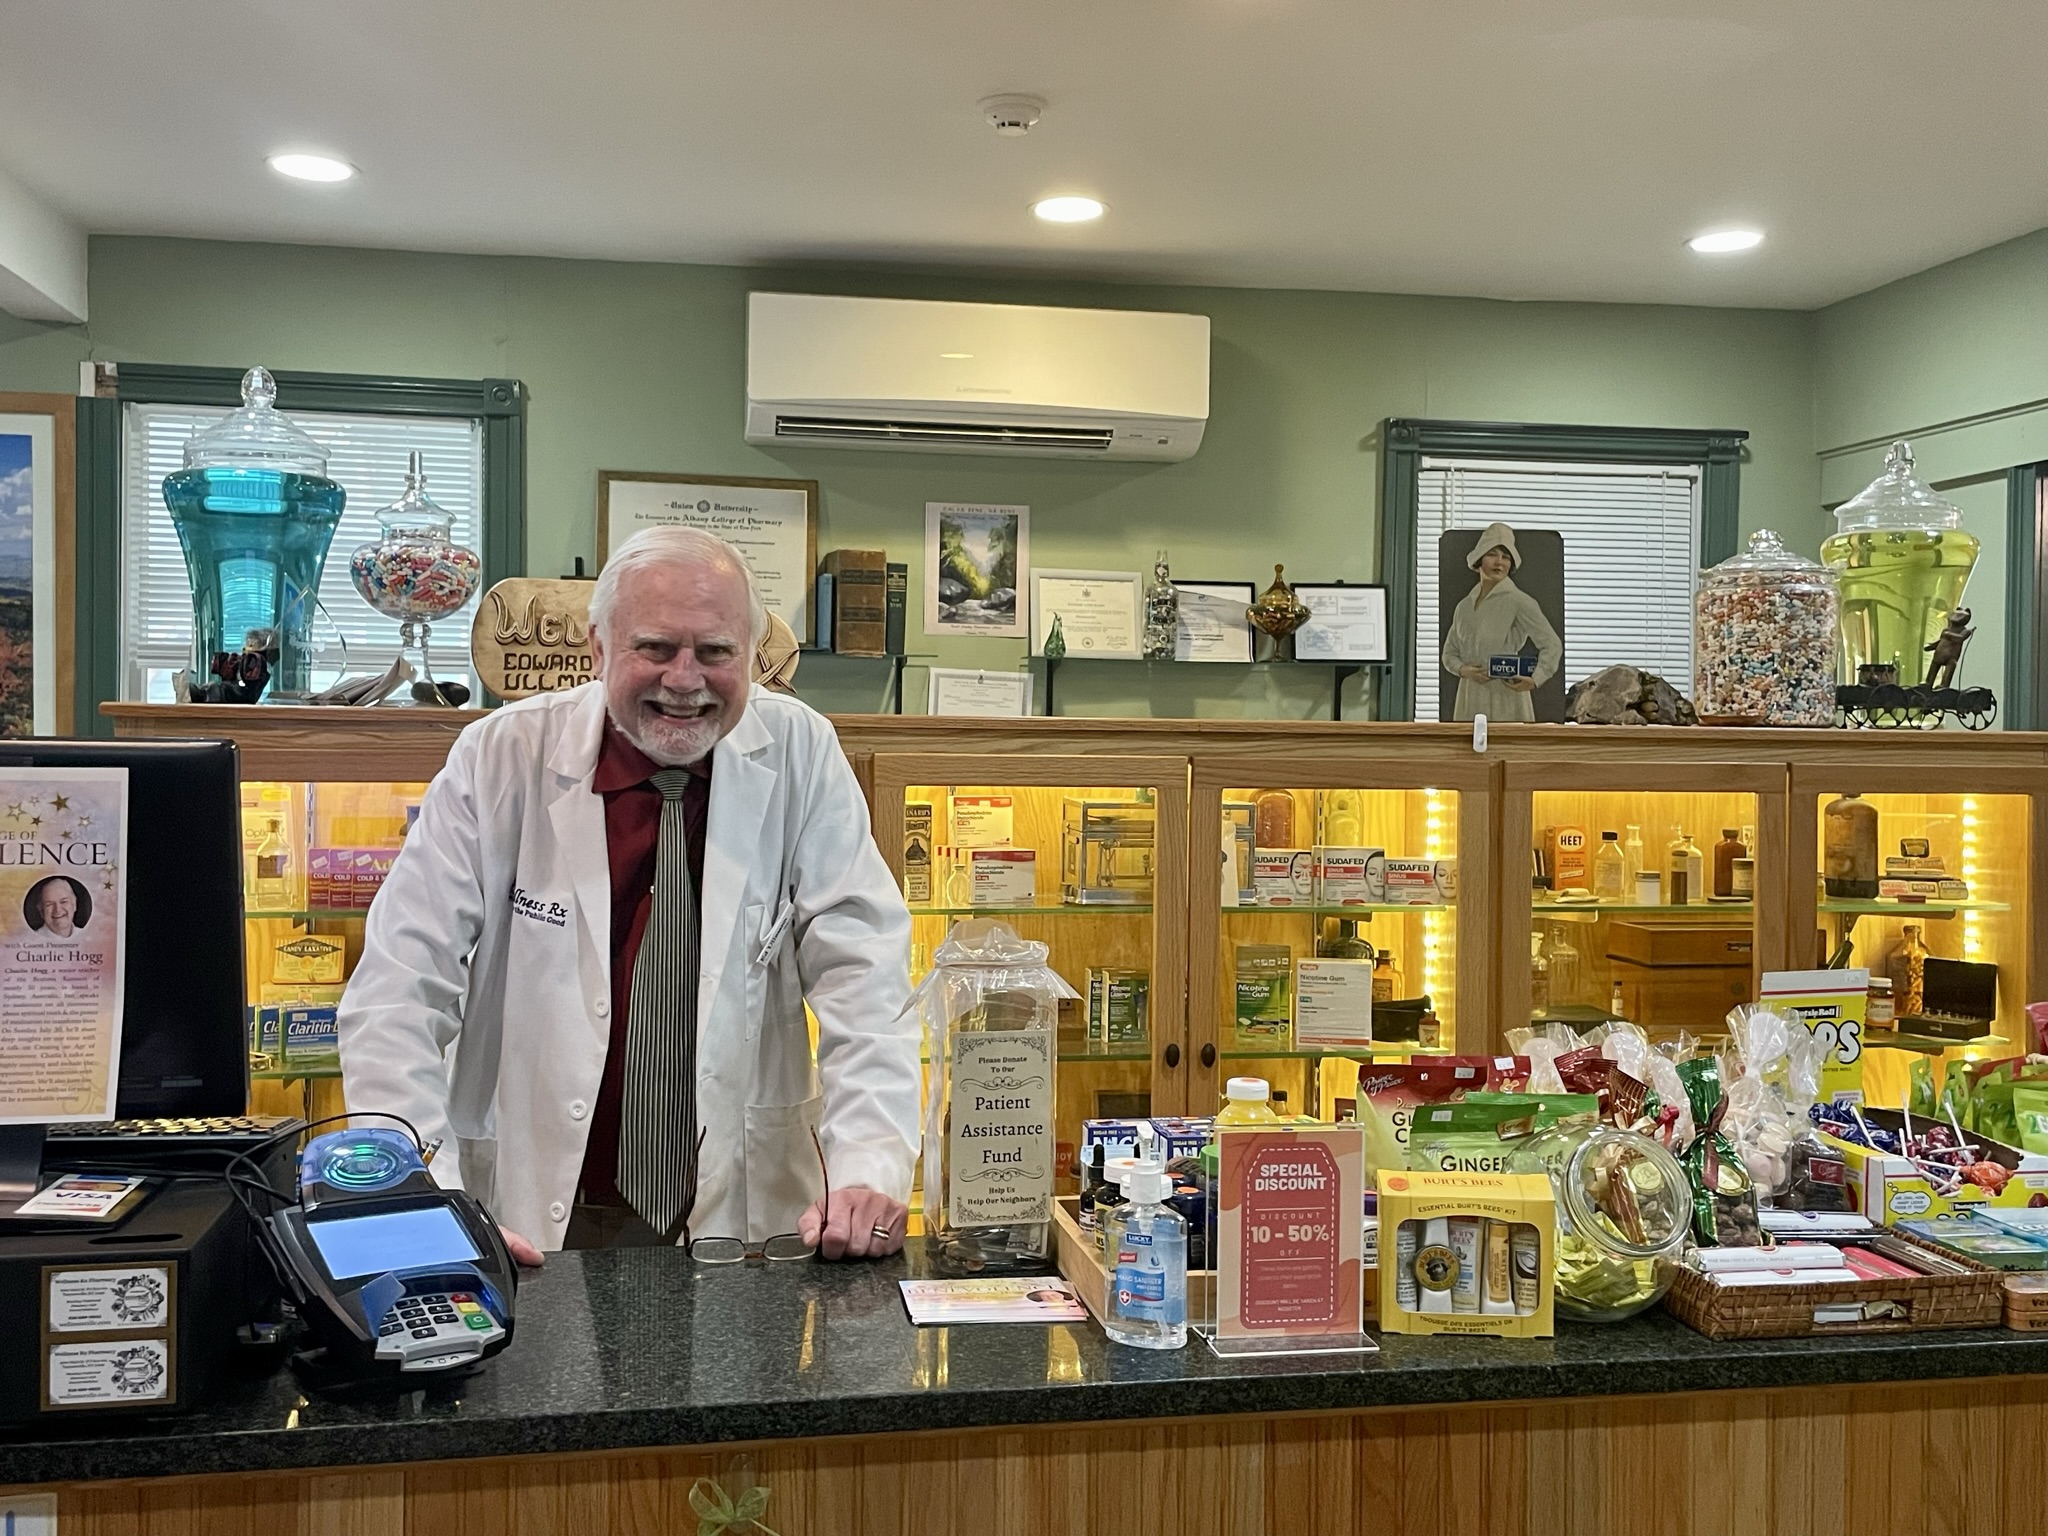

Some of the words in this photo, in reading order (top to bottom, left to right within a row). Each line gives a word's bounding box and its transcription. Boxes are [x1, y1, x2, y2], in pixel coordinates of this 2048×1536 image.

[503, 652, 593, 672] EDWARD
[1491, 663, 1516, 674] KOTEX
[0, 831, 15, 840] GE
[20, 831, 37, 840] OF
[1560, 835, 1583, 846] HEET
[1388, 864, 1430, 872] SUDAFED
[510, 884, 547, 912] llness
[524, 908, 546, 922] Public
[546, 916, 566, 928] Good
[304, 945, 333, 953] LAXATIVE
[16, 950, 64, 962] Charlie
[68, 950, 104, 966] Hogg
[1237, 984, 1270, 992] Nicotine
[978, 1056, 1001, 1064] Please
[975, 1095, 1031, 1111] Patient
[961, 1122, 1043, 1138] Assistance
[982, 1147, 1023, 1164] Fund
[1260, 1163, 1322, 1177] SPECIAL
[1255, 1177, 1328, 1191] DISCOUNT
[1471, 1178, 1505, 1187] BEES
[56, 1192, 112, 1200] VISA
[988, 1187, 1005, 1195] Help
[967, 1198, 984, 1206] Help
[1000, 1196, 1036, 1205] Neighbors
[1418, 1203, 1455, 1213] ESSENTIAL
[1504, 1208, 1517, 1216] KIT
[1260, 1212, 1321, 1220] DISCOUNT
[1250, 1225, 1271, 1243] 10
[1288, 1224, 1330, 1243] 50%
